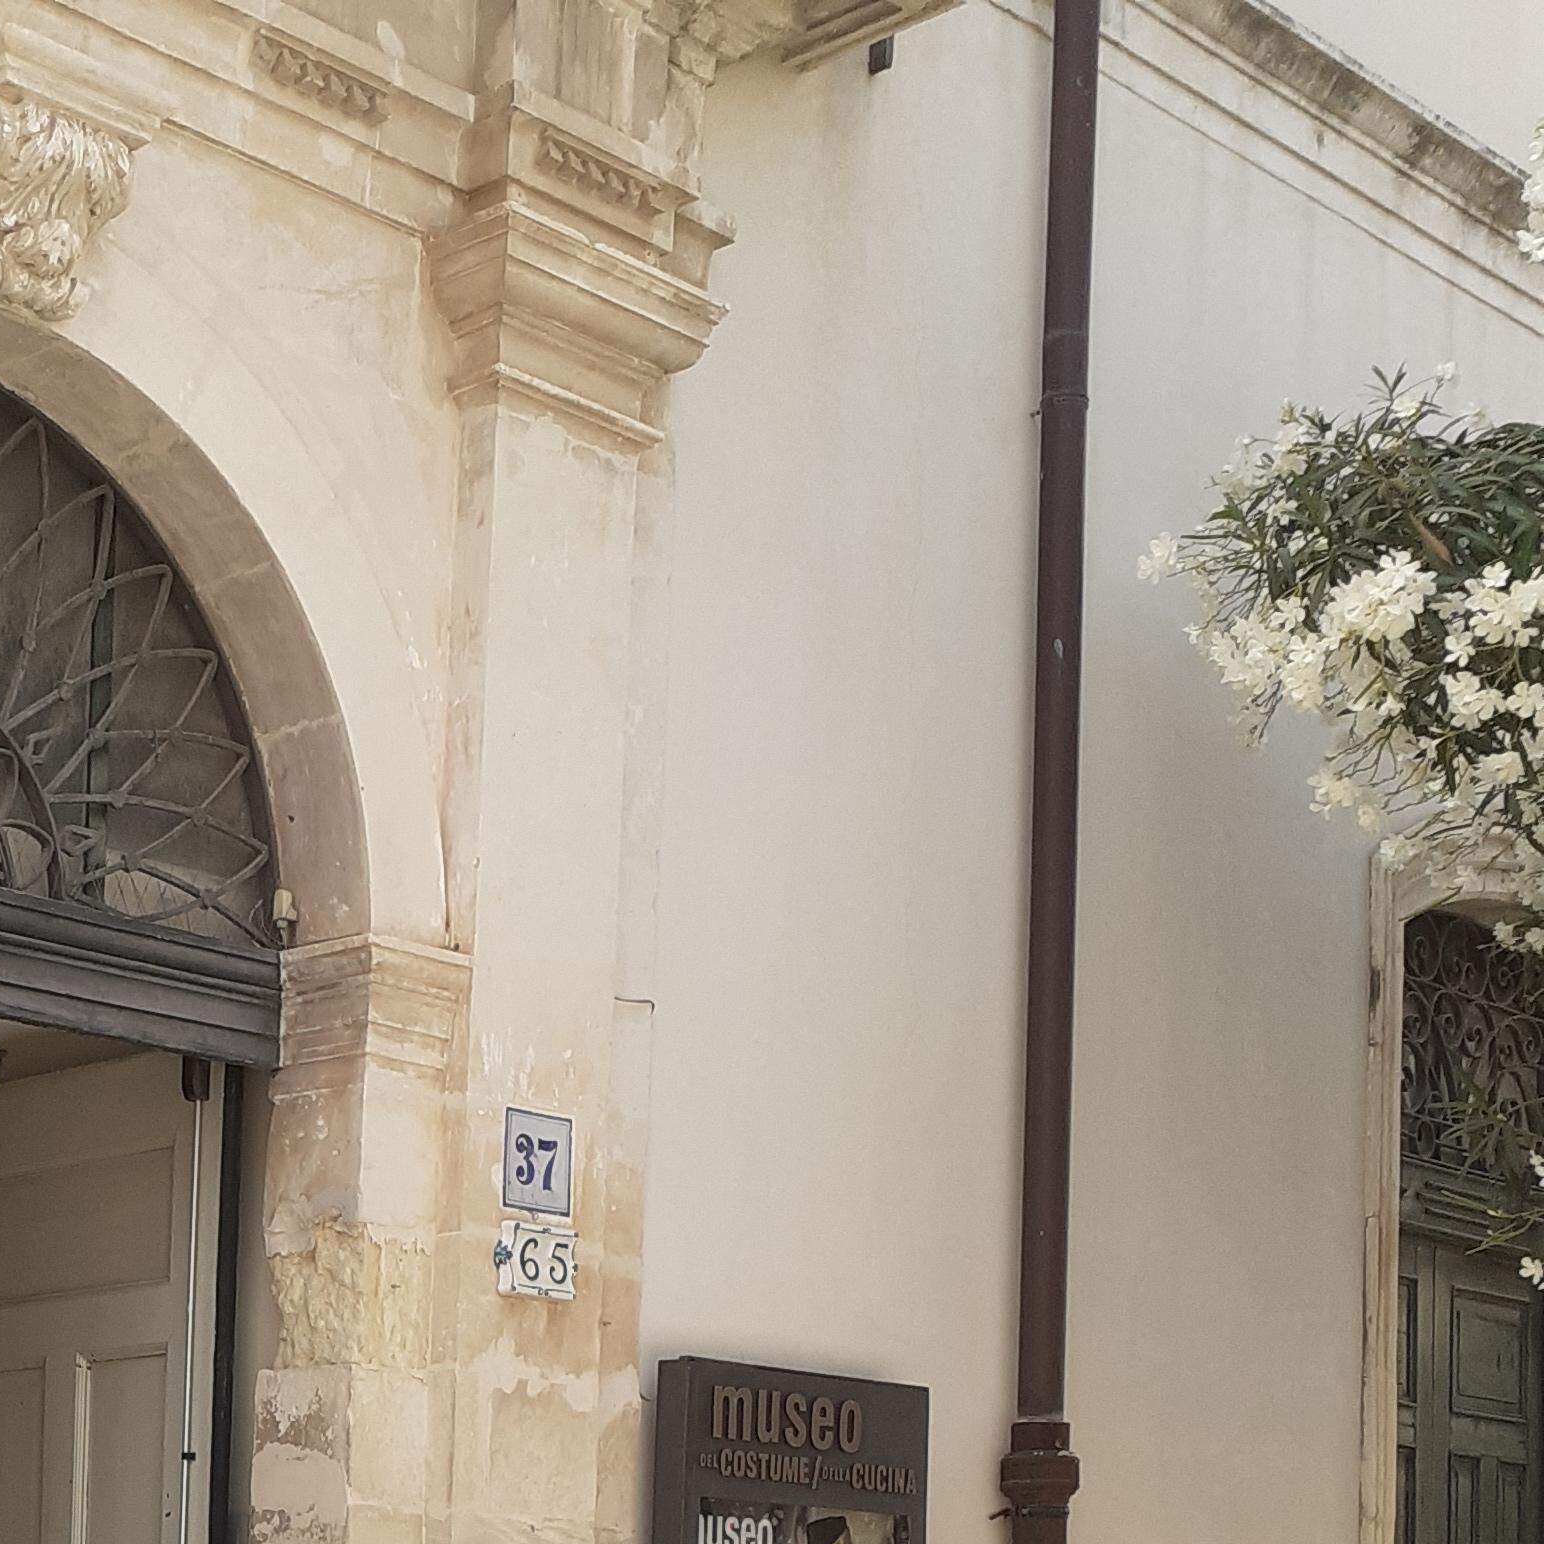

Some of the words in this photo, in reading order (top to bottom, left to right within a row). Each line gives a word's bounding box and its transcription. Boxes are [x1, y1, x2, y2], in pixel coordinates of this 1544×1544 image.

[515, 1133, 558, 1192] 37
[519, 1237, 569, 1285] 65
[712, 1385, 863, 1453] museo
[699, 1453, 719, 1469] DEL
[851, 1463, 918, 1496] CUCINA
